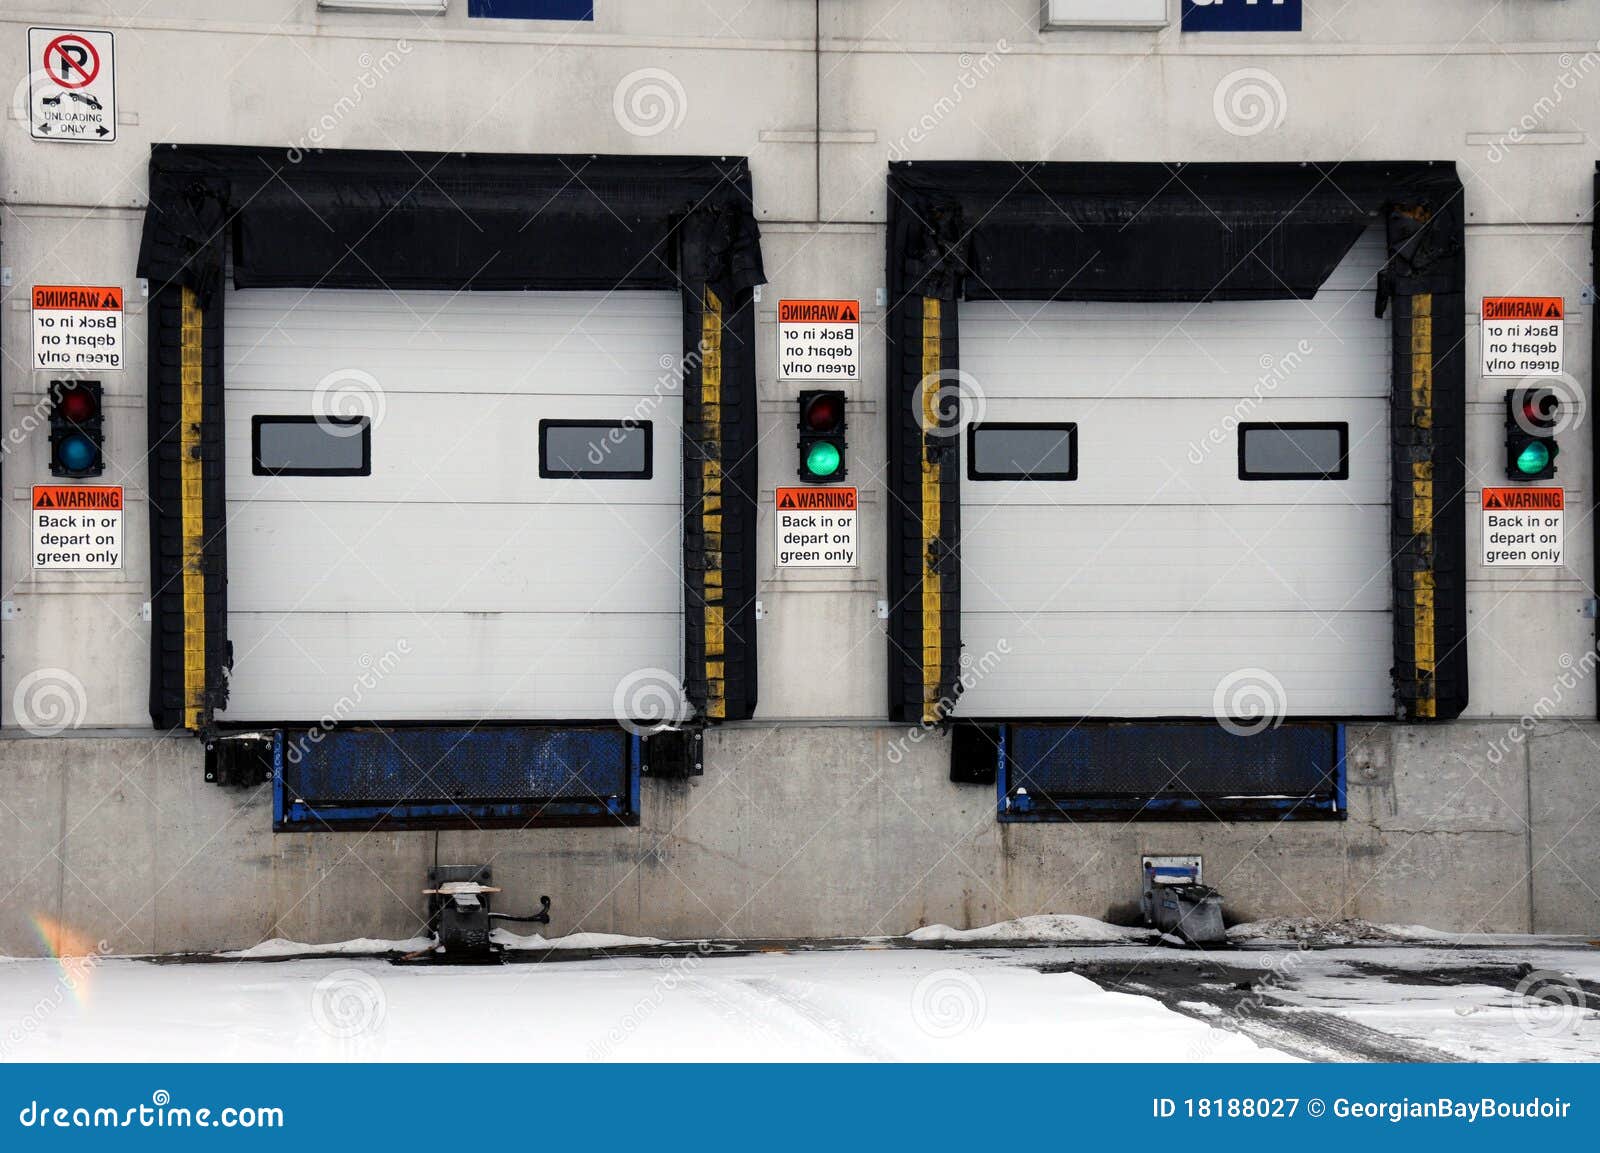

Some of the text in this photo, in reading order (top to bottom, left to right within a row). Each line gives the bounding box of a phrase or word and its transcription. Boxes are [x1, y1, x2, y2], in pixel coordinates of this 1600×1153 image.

[61, 45, 88, 79] P
[44, 112, 102, 123] UNLOADING
[60, 124, 87, 134] ONLY
[56, 491, 119, 507] WARNING
[797, 492, 854, 508] WARNING
[1503, 493, 1560, 508] WARNING
[39, 515, 117, 527] Back in or
[782, 515, 852, 527] Back in or
[1488, 515, 1559, 527] Back in or
[40, 533, 114, 548] depart on
[784, 532, 850, 547] depart on
[1490, 532, 1557, 546] depart on
[36, 550, 118, 566] green only
[780, 549, 853, 564] green only
[1486, 549, 1560, 563] green only
